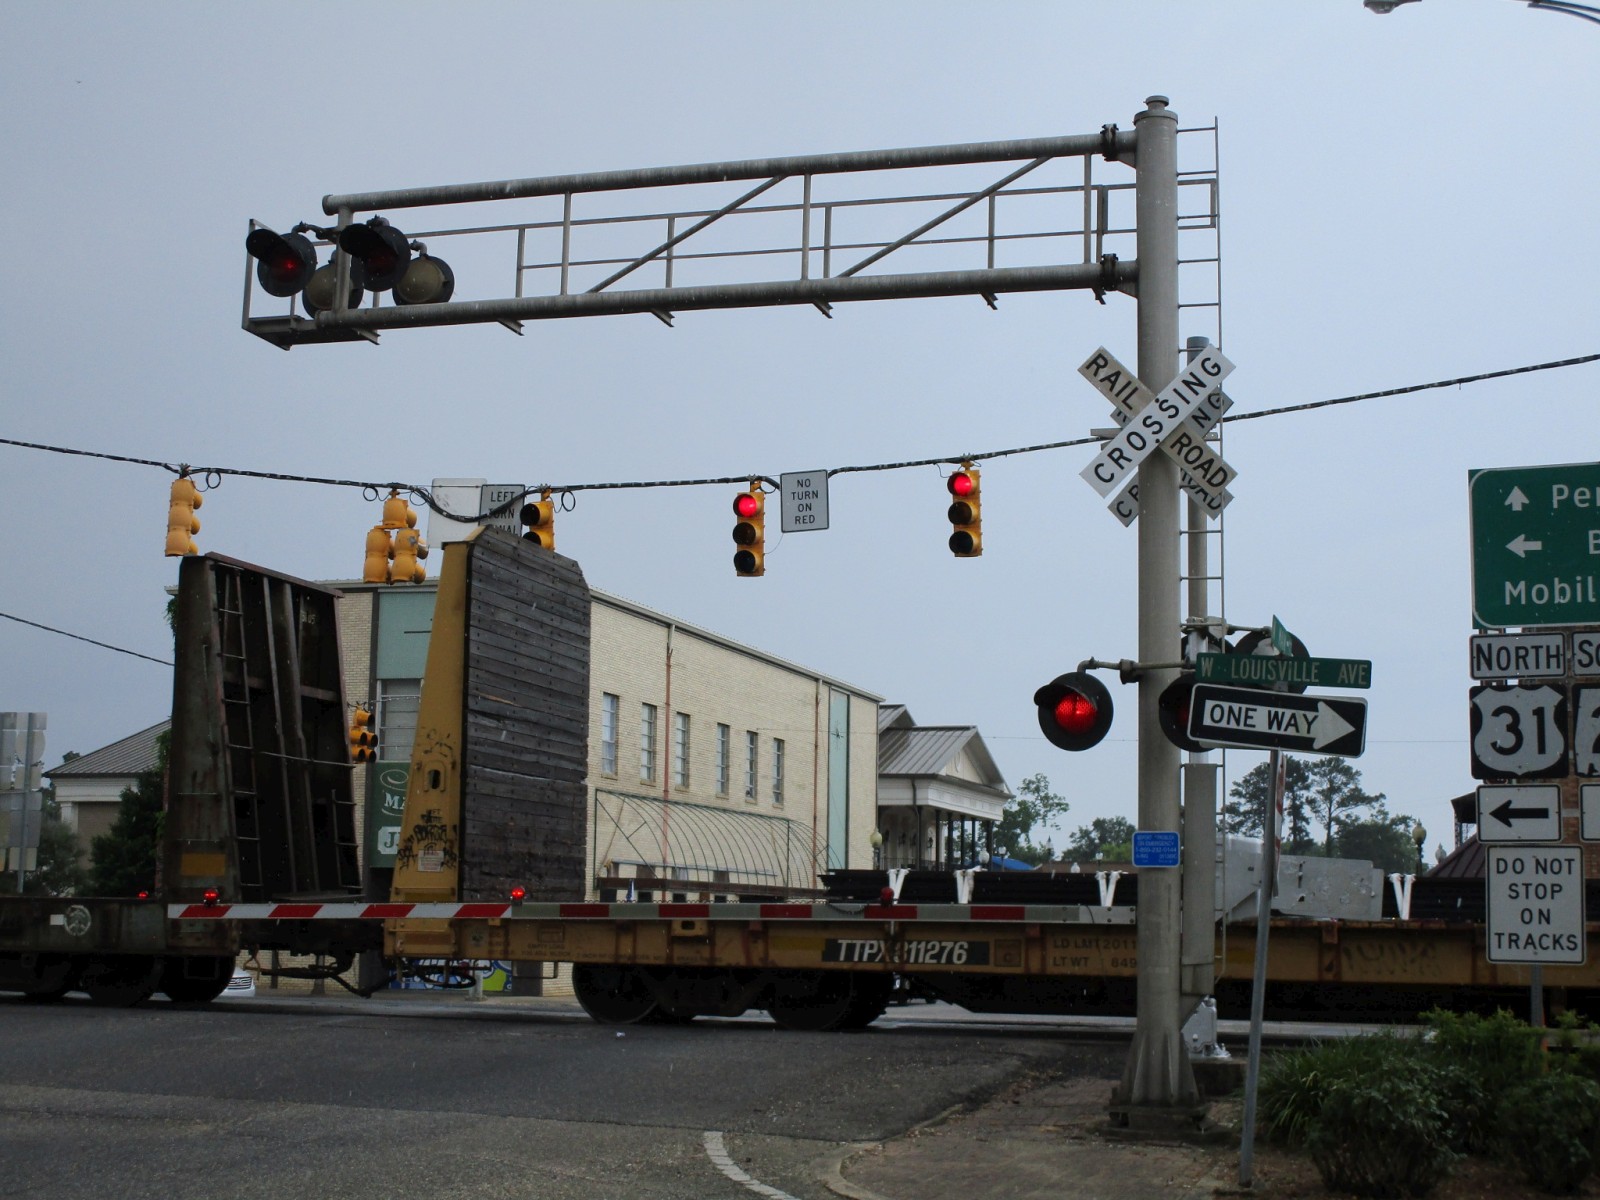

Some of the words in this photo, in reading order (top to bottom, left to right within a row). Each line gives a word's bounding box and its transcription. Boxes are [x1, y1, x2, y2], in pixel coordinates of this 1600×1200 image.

[1085, 353, 1139, 410] RAIL
[1170, 432, 1228, 487] ROAD
[1094, 357, 1222, 483] CROSSING
[797, 478, 811, 488] NO
[490, 491, 515, 502] LEFT
[791, 490, 819, 500] TURN
[797, 502, 812, 512] ON
[794, 514, 815, 525] RED
[1504, 576, 1597, 605] Mobil
[1475, 643, 1561, 671] NORTH
[1201, 657, 1214, 678] W
[1231, 658, 1320, 683] LOUISVILLE
[1337, 663, 1368, 685] AVE
[1209, 703, 1257, 728] ONE
[1267, 709, 1319, 735] WAY
[1490, 705, 1546, 755] 31
[1496, 857, 1525, 875] DO
[1535, 858, 1575, 875] NOT
[1507, 882, 1563, 900] STOP
[1520, 907, 1551, 925] ON
[837, 939, 890, 962] TTPX
[1053, 938, 1070, 949] LD
[1494, 932, 1578, 951] TRACKS
[1053, 956, 1066, 967] LT
[1070, 956, 1089, 967] WT
